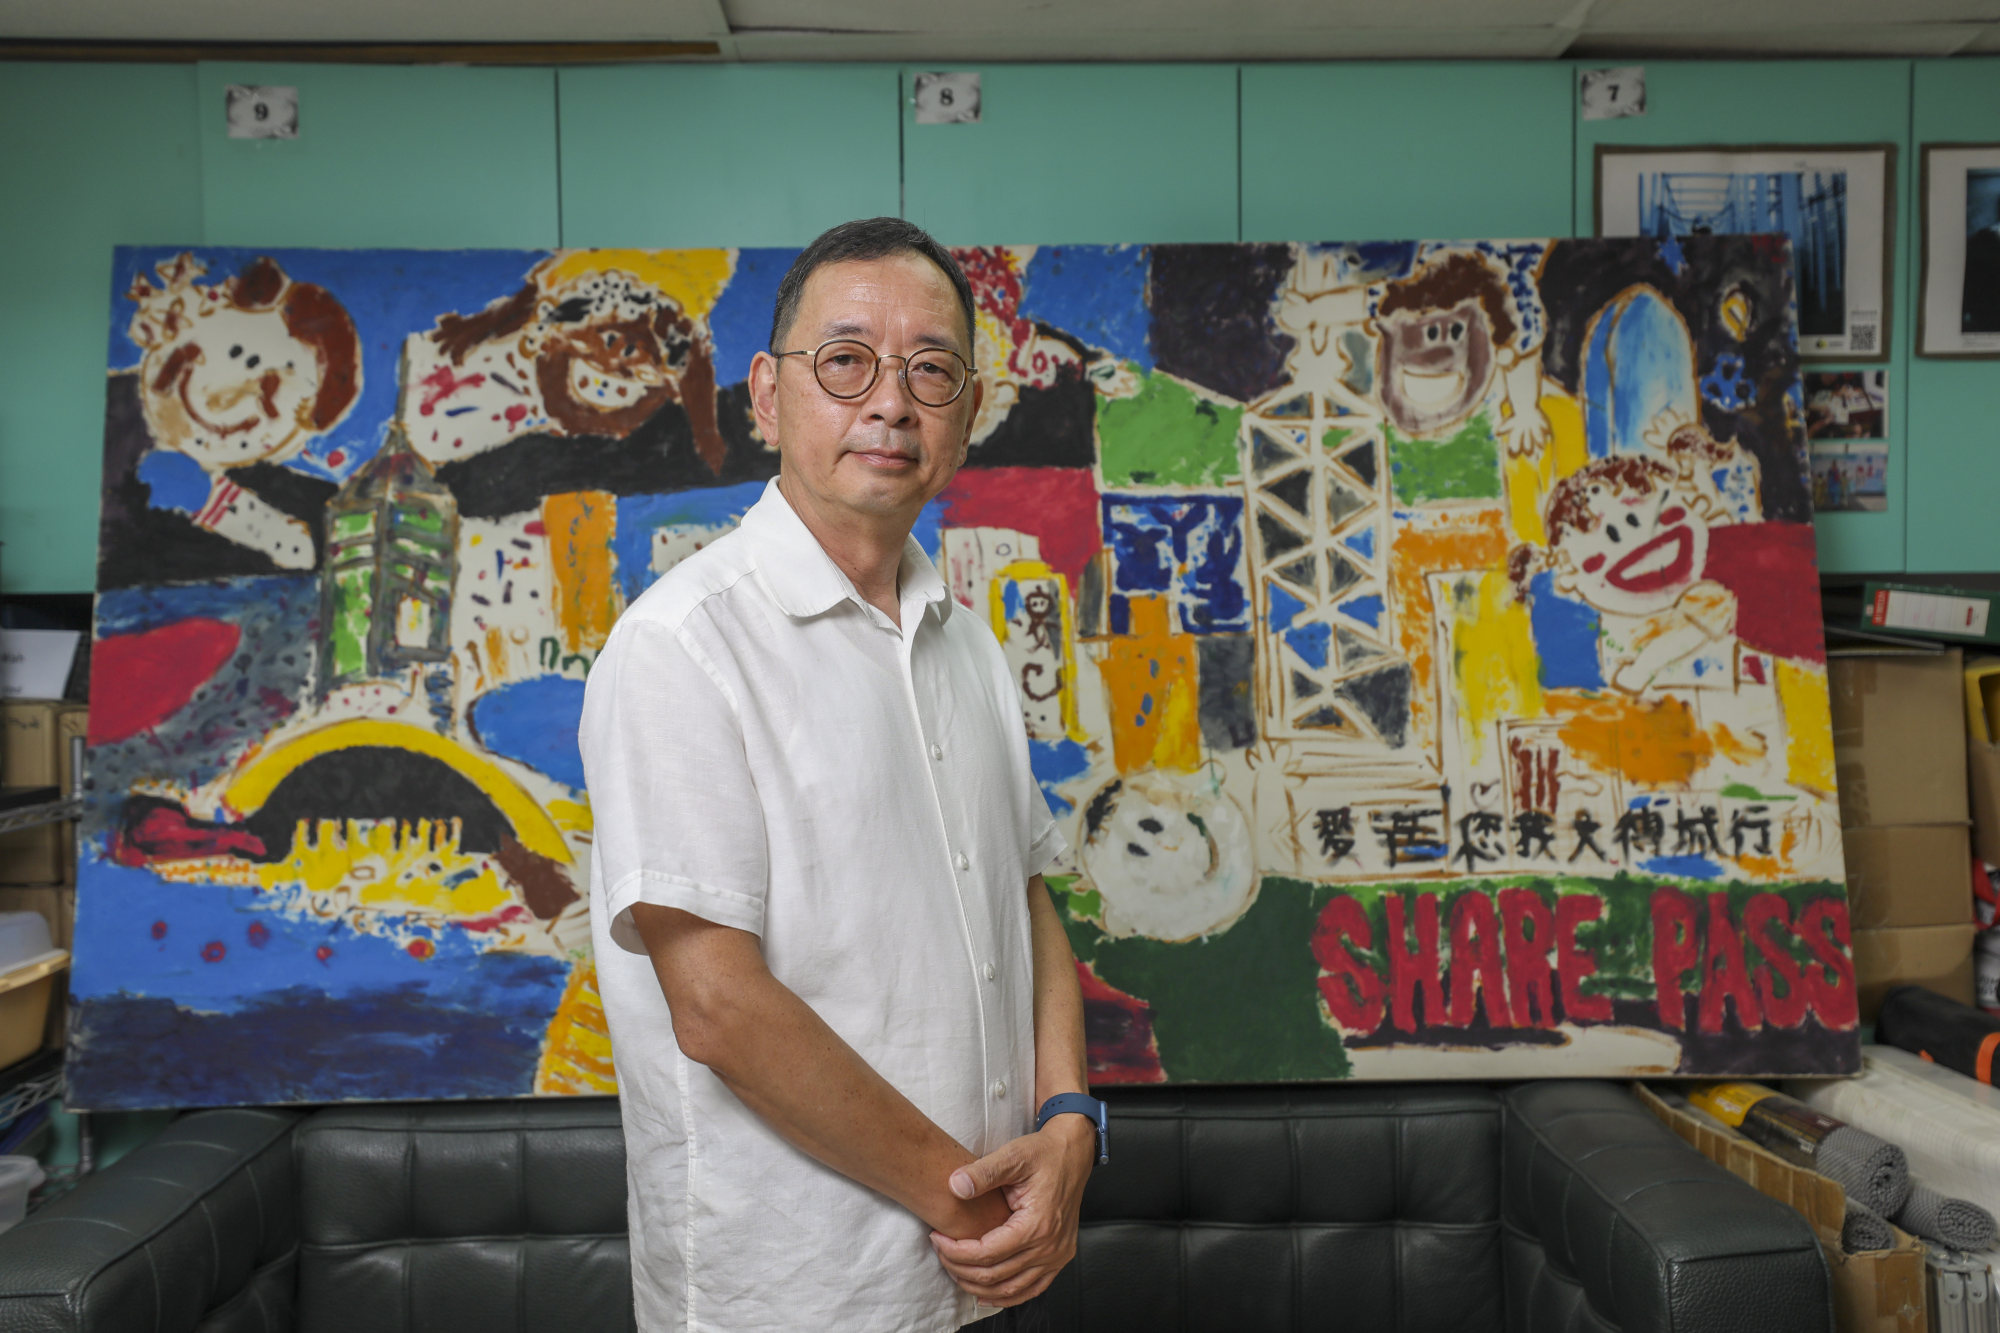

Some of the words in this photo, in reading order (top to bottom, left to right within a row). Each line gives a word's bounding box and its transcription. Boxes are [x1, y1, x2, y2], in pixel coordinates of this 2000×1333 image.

[940, 87, 954, 107] 8
[1607, 84, 1620, 102] 7
[254, 102, 269, 121] 9
[1311, 887, 1613, 1036] SHARE
[1650, 886, 1860, 1034] PASS
